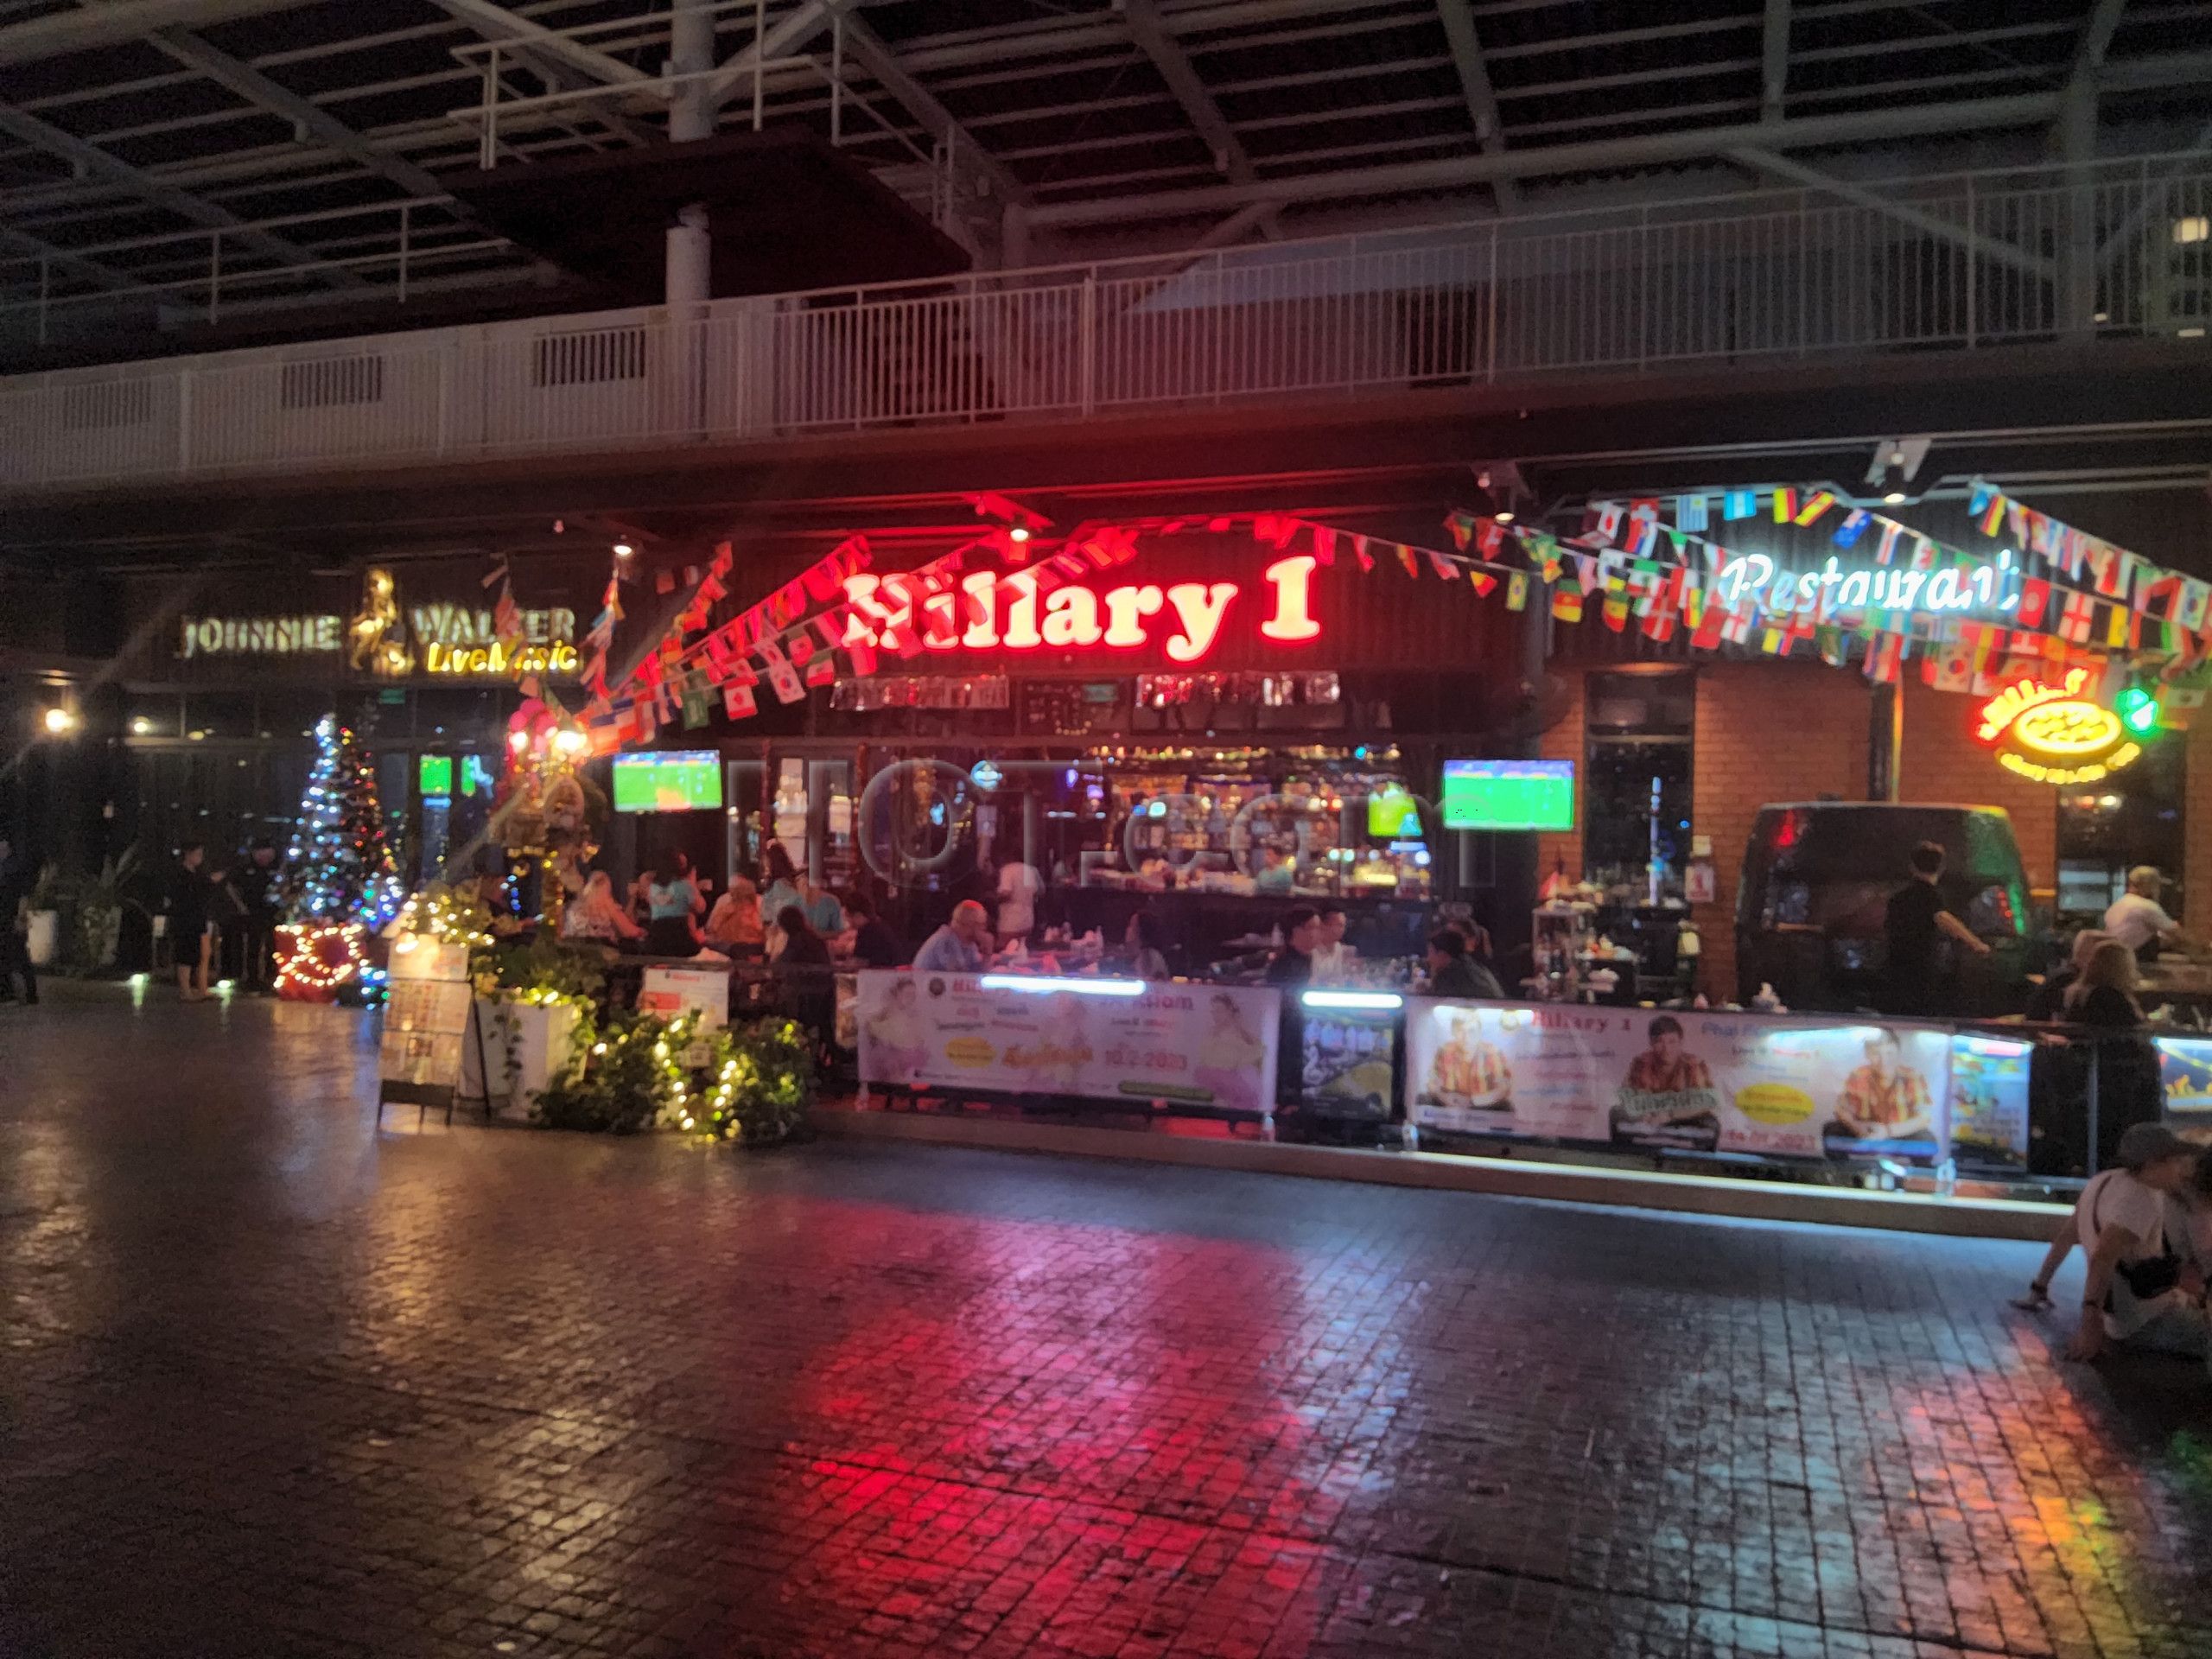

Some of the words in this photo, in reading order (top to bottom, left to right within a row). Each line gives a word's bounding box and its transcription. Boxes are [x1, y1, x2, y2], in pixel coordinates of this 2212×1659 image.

[176, 614, 342, 659] JOHNNIE
[412, 603, 575, 644] WALER
[841, 570, 1238, 663] Hillary
[1261, 556, 1320, 641] 1
